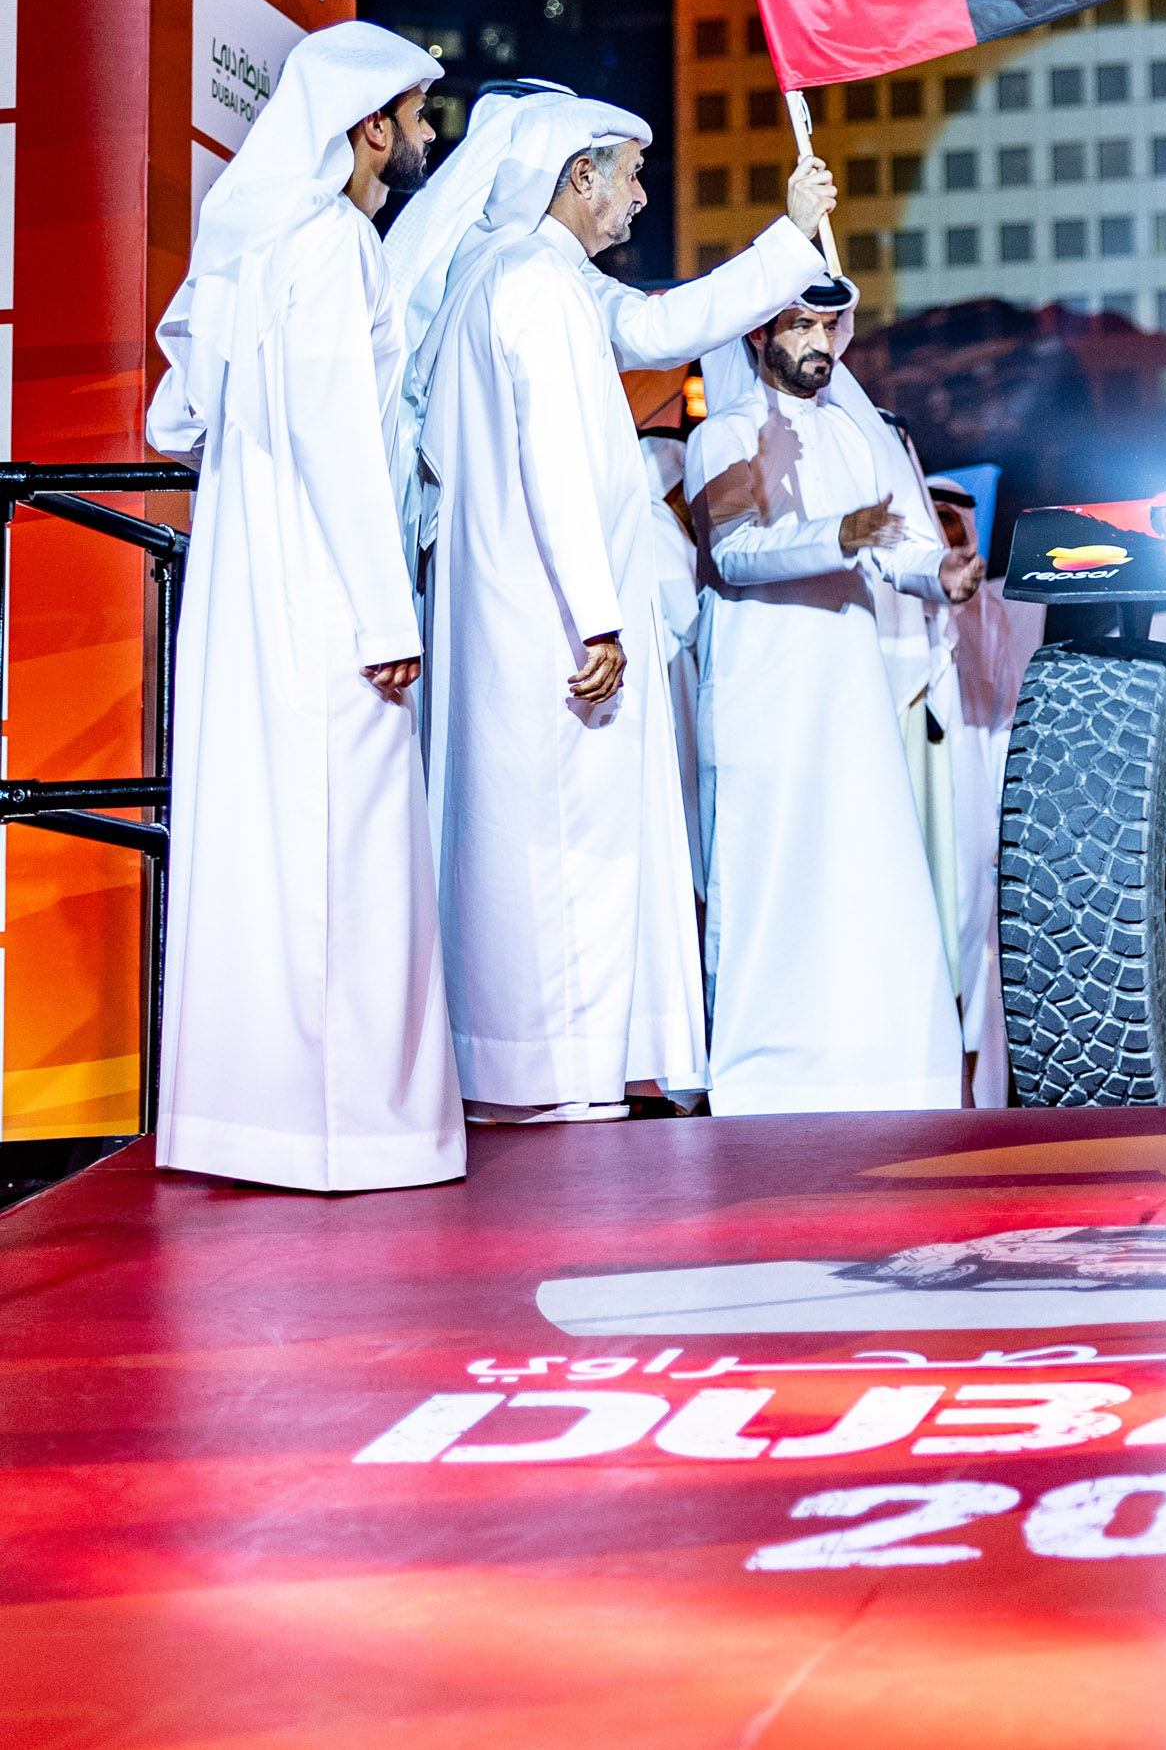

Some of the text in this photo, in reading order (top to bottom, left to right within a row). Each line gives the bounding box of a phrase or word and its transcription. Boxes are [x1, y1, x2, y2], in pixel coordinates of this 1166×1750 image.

[211, 36, 271, 102] شرطة دبي
[211, 78, 239, 115] DUBAI
[1022, 568, 1121, 582] repsol
